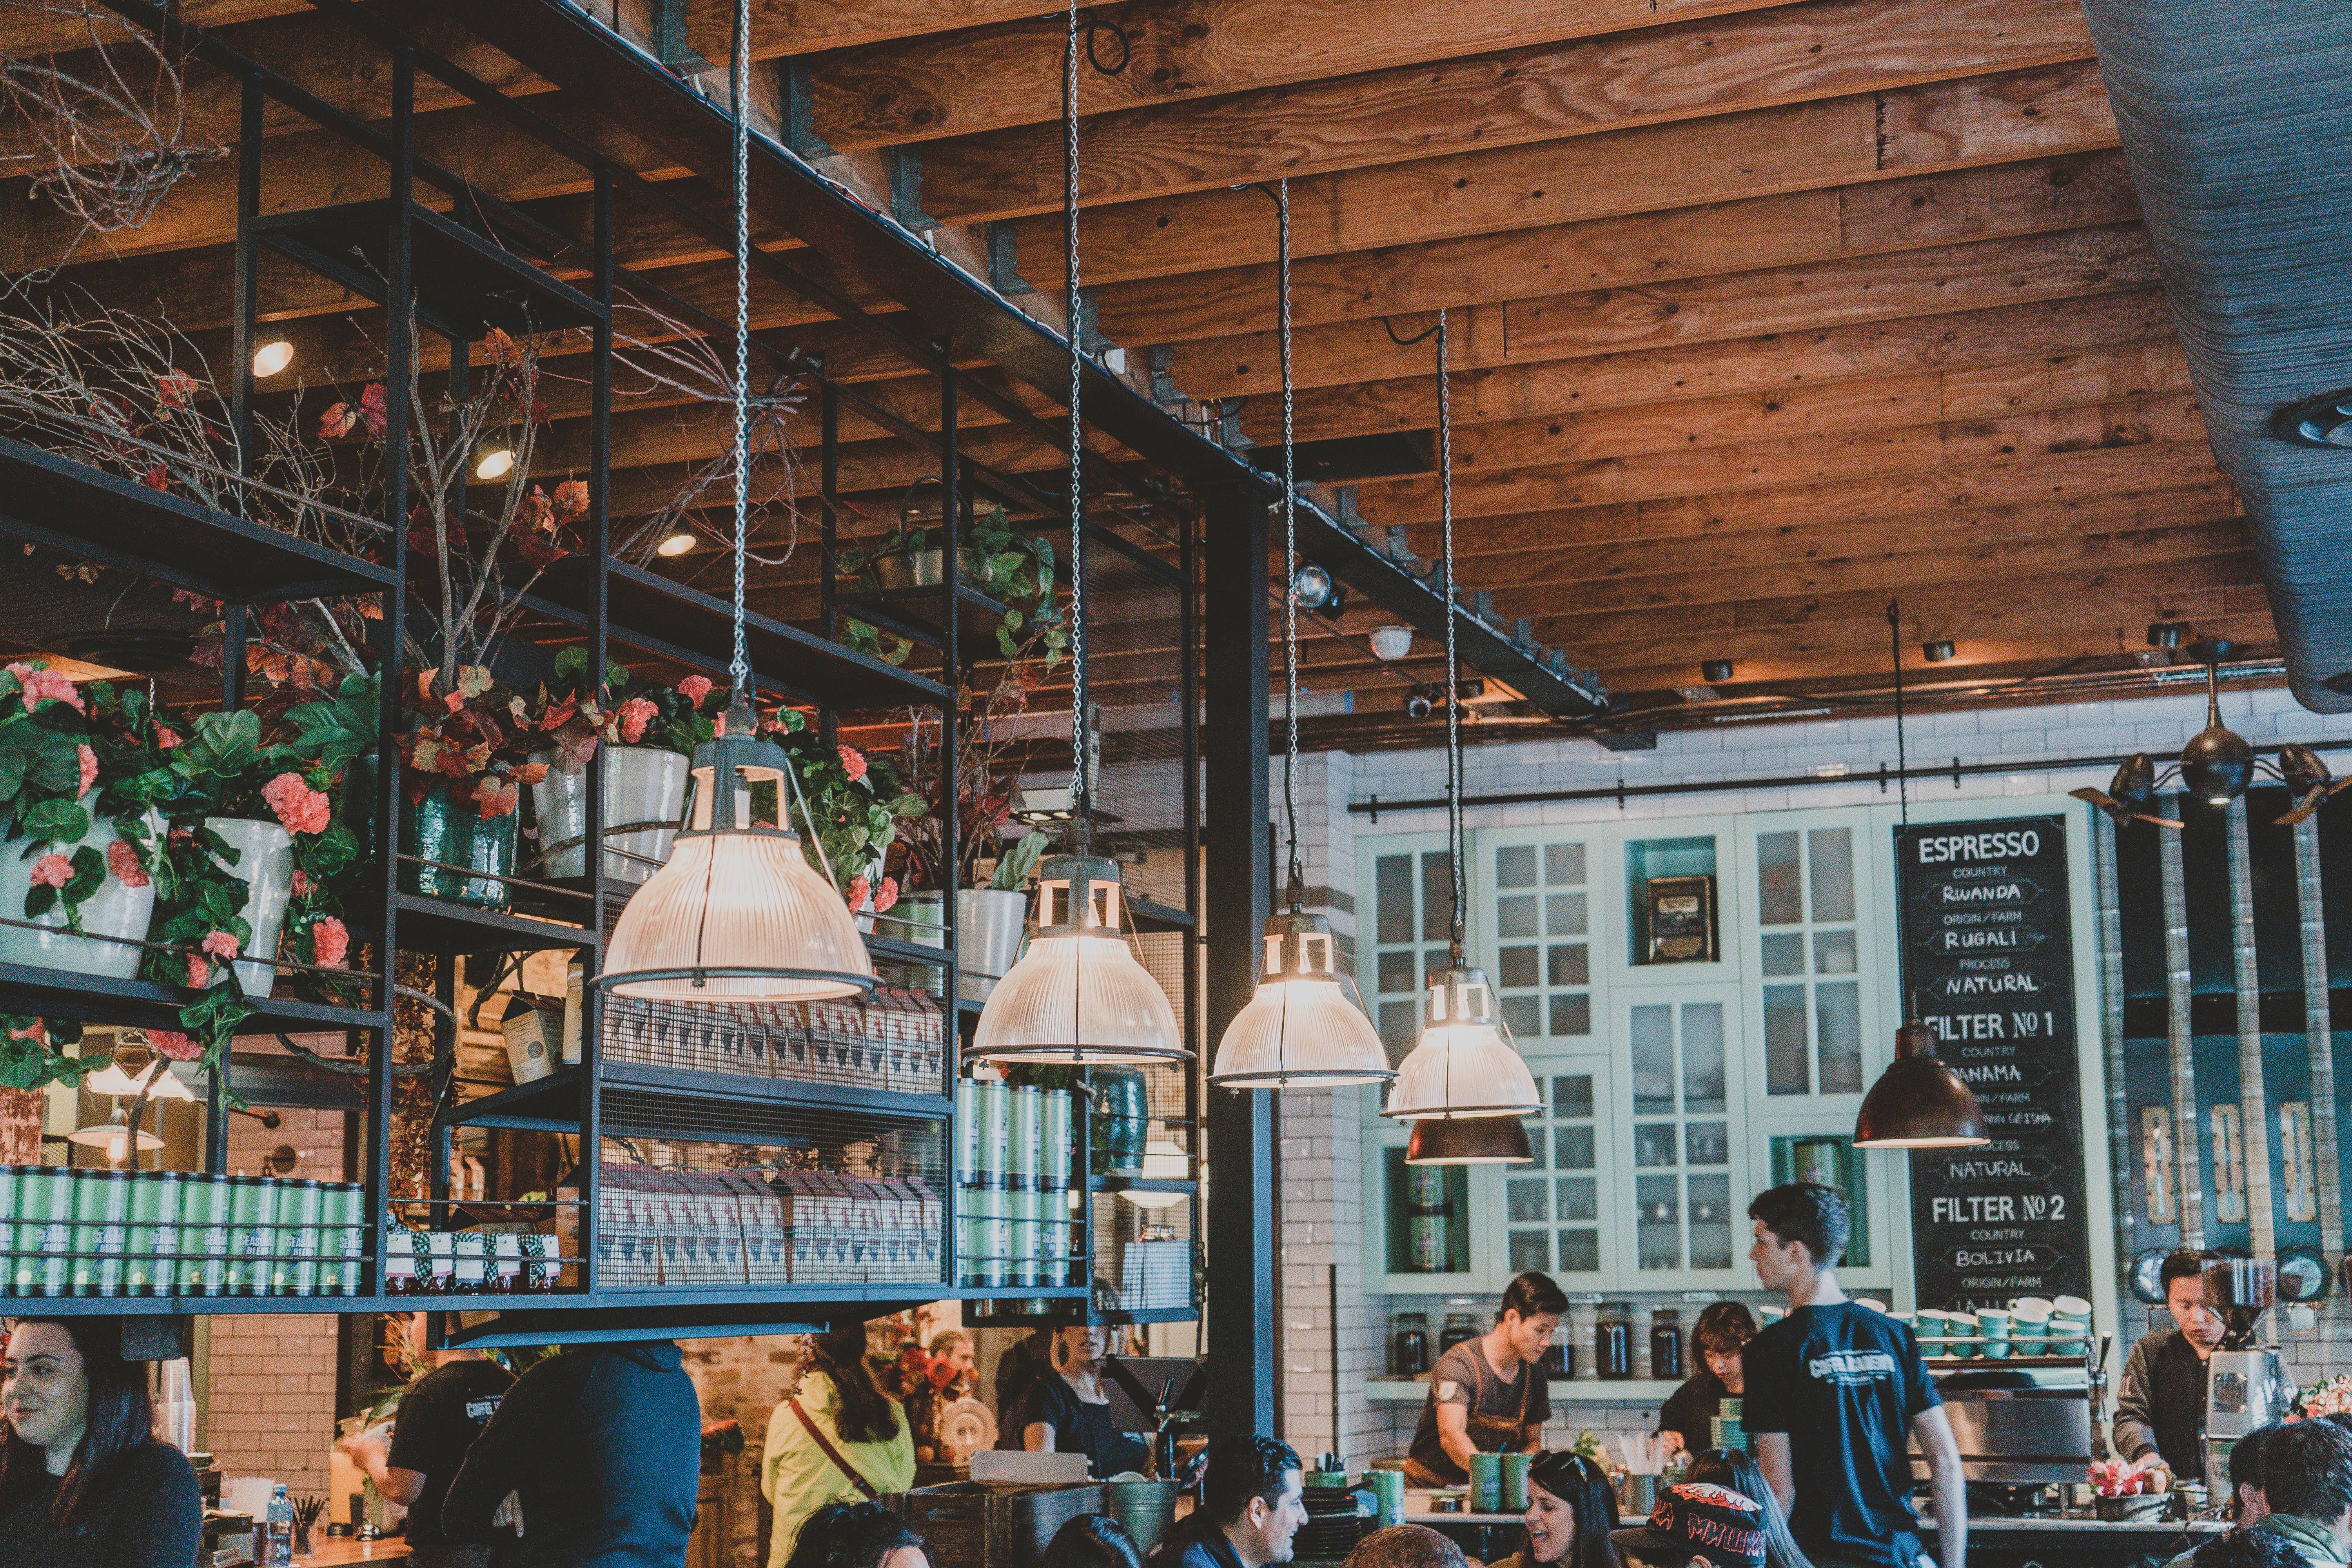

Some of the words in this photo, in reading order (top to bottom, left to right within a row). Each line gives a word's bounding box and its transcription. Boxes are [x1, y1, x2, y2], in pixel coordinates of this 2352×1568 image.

[1919, 830, 2040, 863] ESPRESSO
[1952, 866, 2007, 879] COUNTRY
[1942, 884, 2021, 903] RWANDA
[1944, 930, 2016, 950] RUGALI
[1960, 958, 2011, 970] PROCESS
[1946, 974, 2039, 995] NATURAL
[1924, 1013, 2005, 1041] FILTER
[2044, 1011, 2053, 1037] 1
[1961, 1045, 2016, 1058] COUNTRY
[1949, 1160, 2031, 1178] NATURAL
[1932, 1195, 2014, 1223] FILTER
[2050, 1194, 2065, 1220] 2
[1970, 1229, 2025, 1241] COUNTRY
[1955, 1248, 2036, 1268] BOLIVIA
